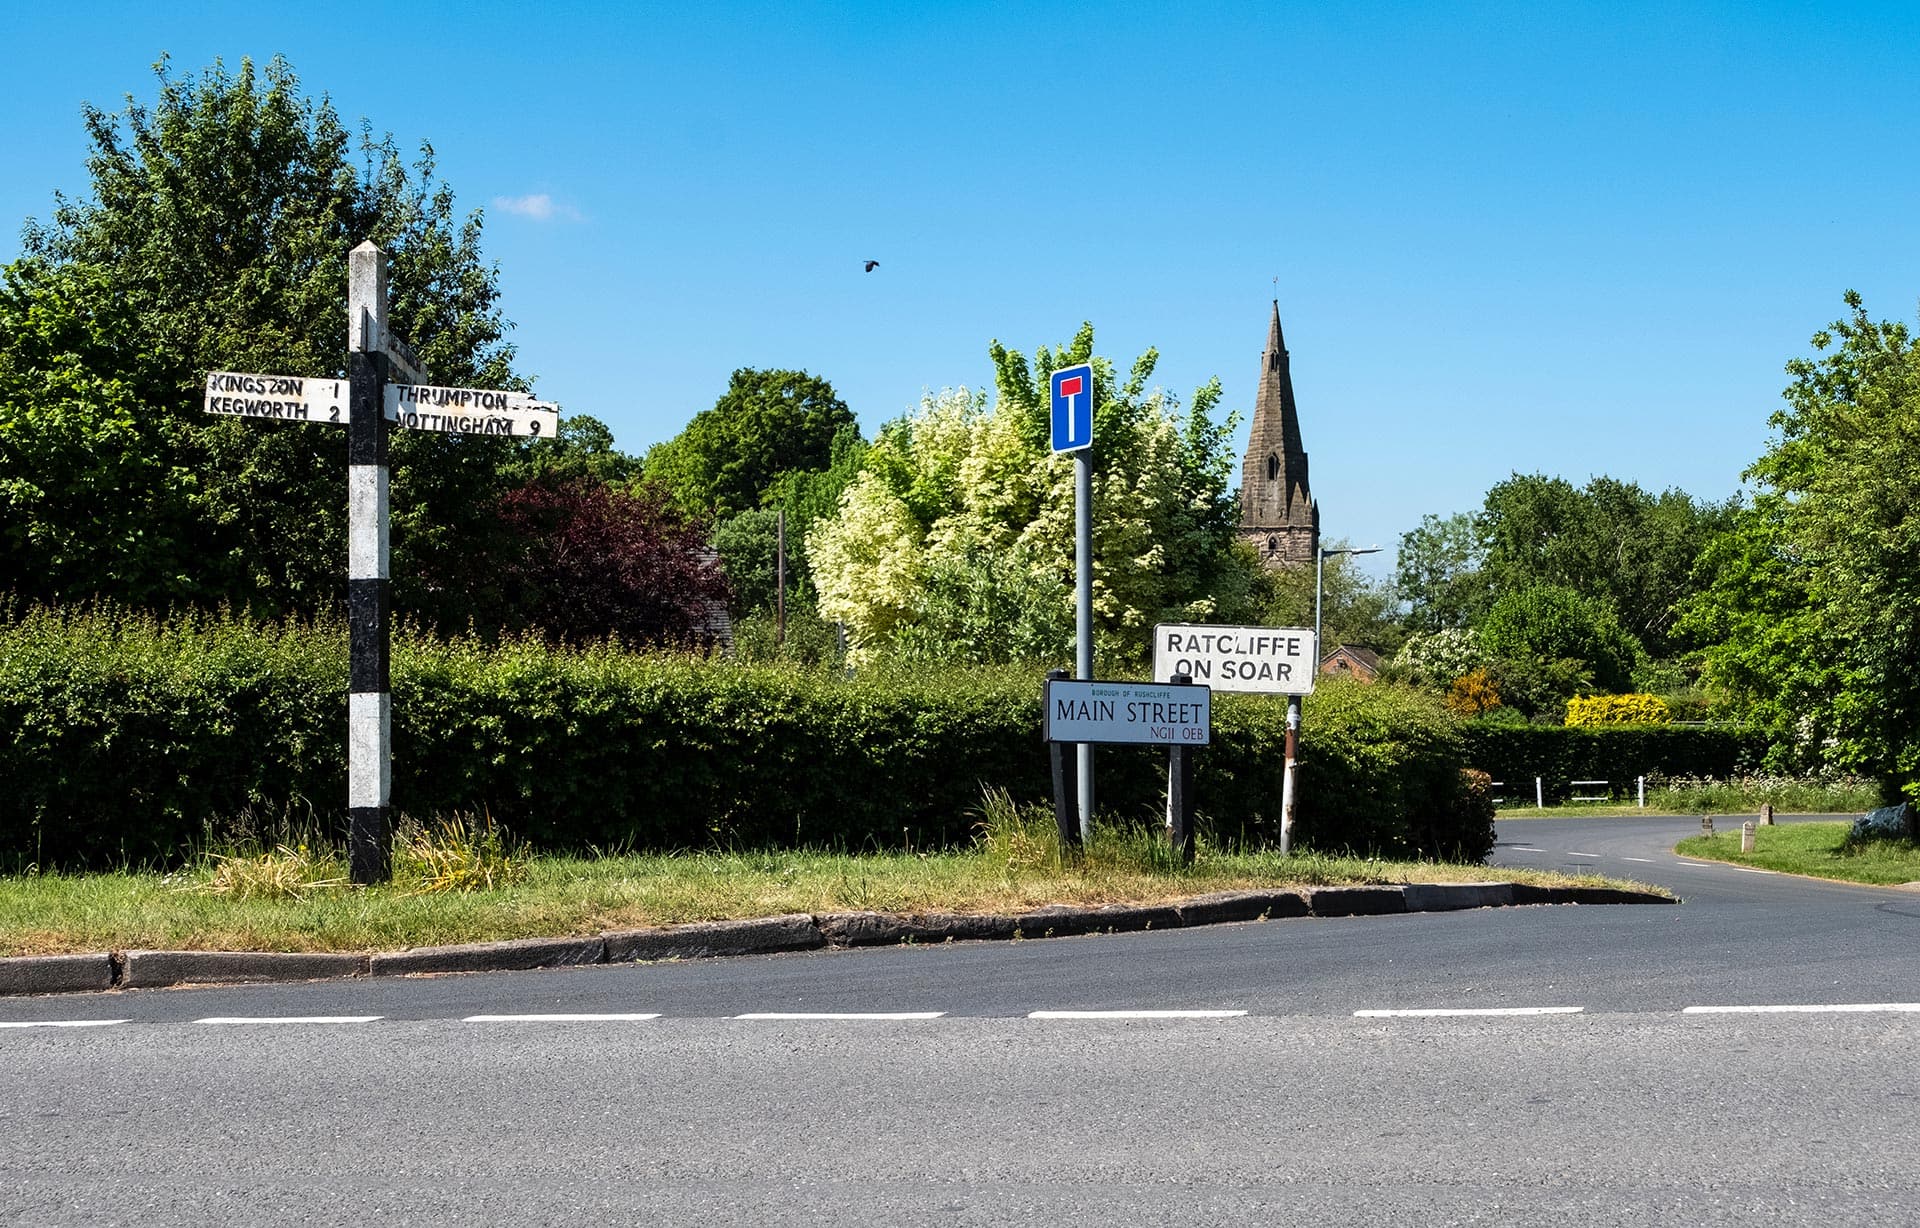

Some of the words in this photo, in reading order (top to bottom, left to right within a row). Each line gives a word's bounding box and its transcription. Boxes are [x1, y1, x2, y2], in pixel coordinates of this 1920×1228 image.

[210, 397, 308, 419] KEGWORTH
[329, 405, 340, 421] 2
[397, 386, 507, 411] THRUMPTON
[396, 412, 514, 435] NOTTINGHAM
[530, 420, 541, 436] 9
[1167, 633, 1301, 657] RATCLIFFE
[1175, 658, 1211, 679] ON
[1221, 660, 1292, 681] SOAR
[1091, 689, 1119, 697] BOROUGH
[1134, 690, 1171, 699] RUSHCLIFFE
[1057, 700, 1115, 721] MAIN
[1127, 702, 1203, 724] STREET
